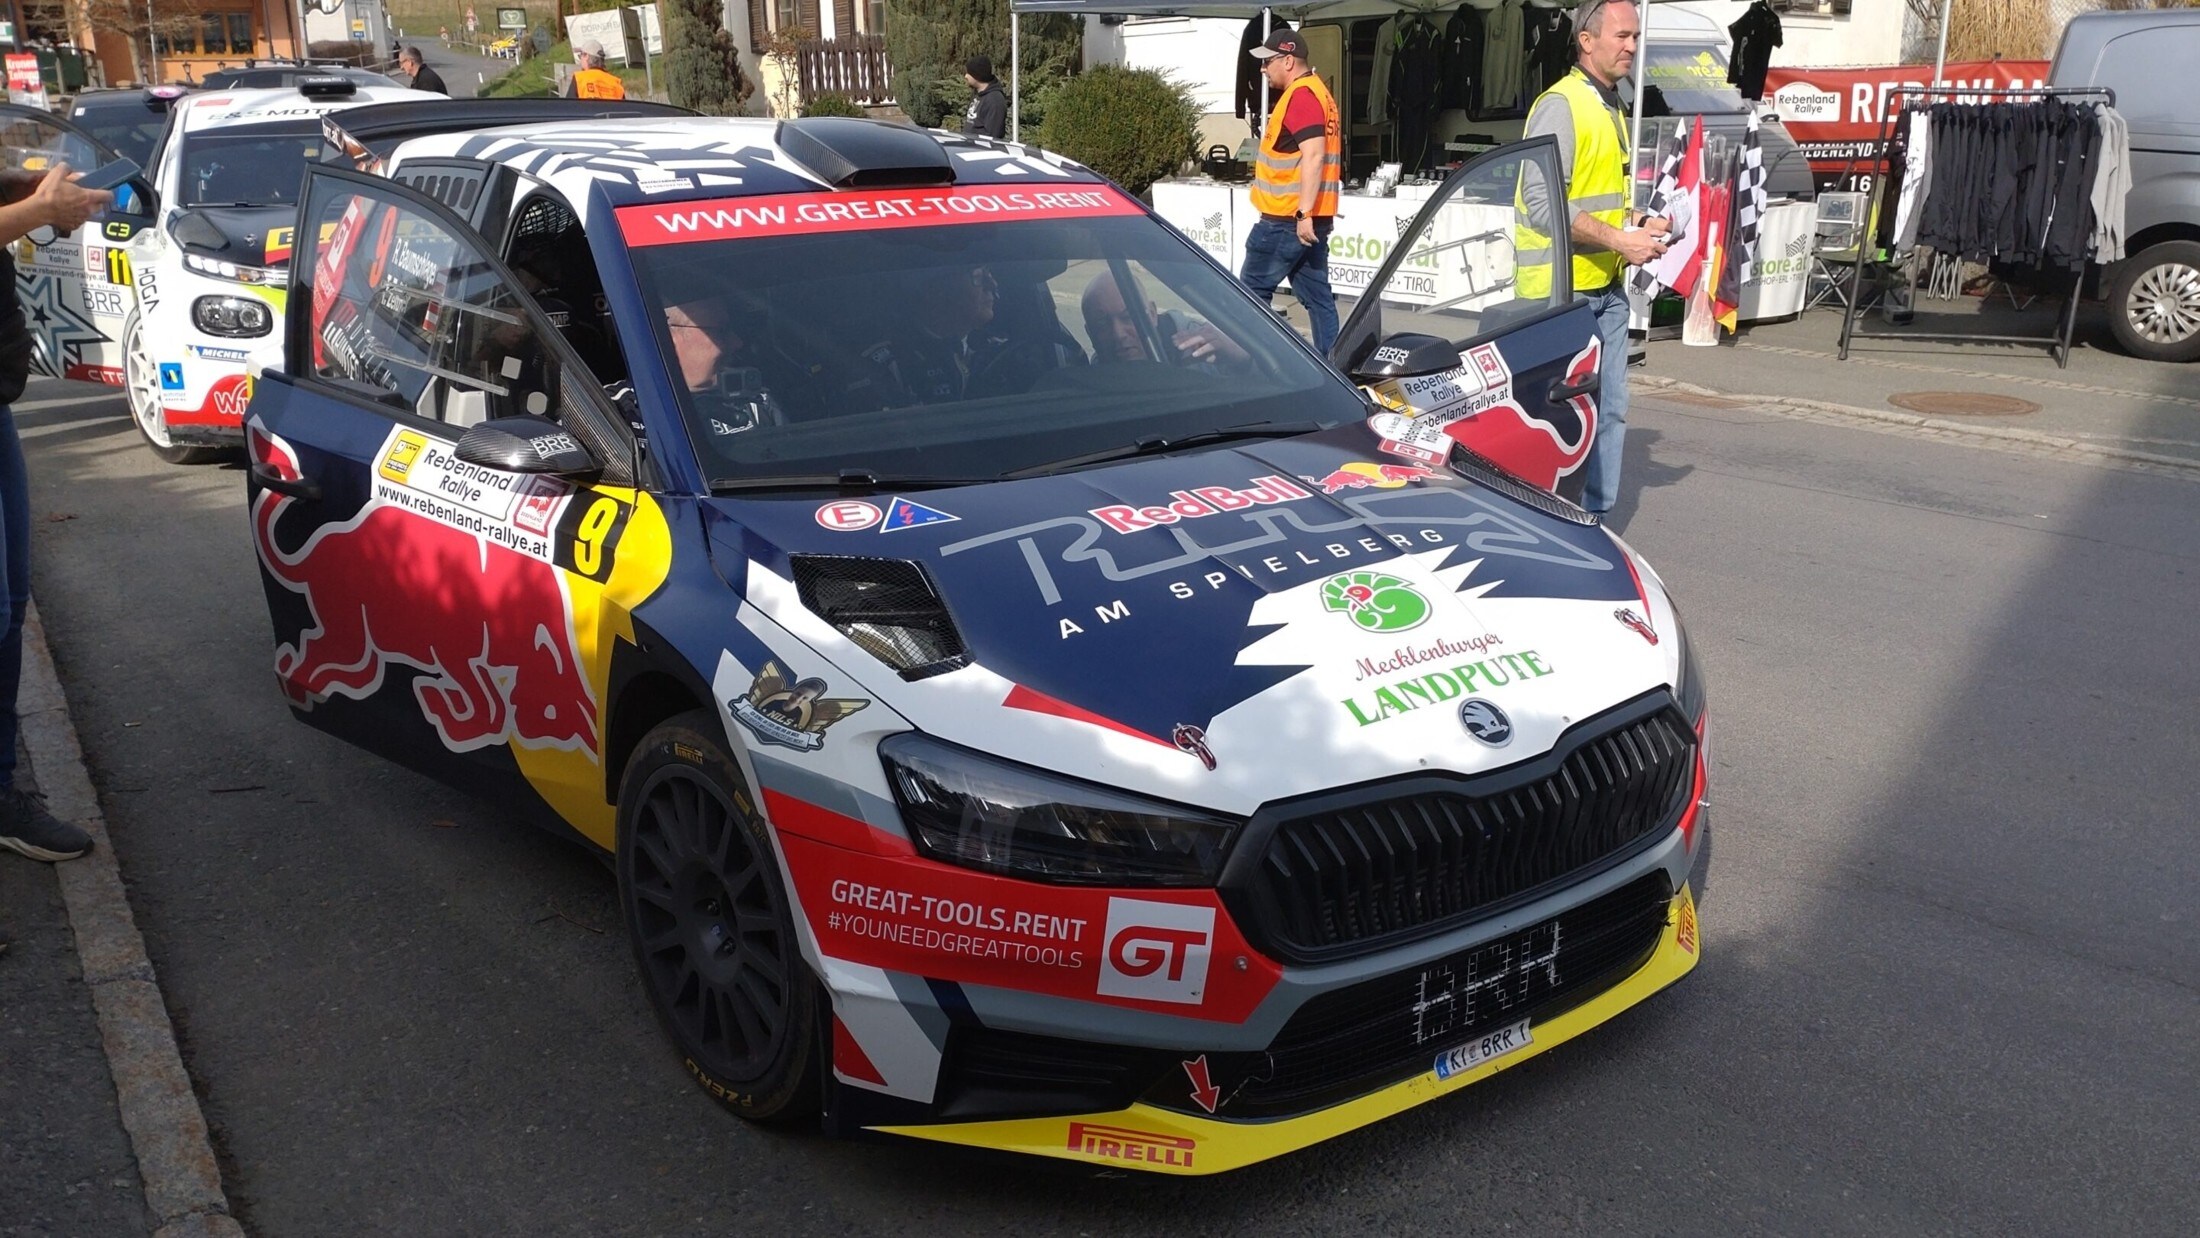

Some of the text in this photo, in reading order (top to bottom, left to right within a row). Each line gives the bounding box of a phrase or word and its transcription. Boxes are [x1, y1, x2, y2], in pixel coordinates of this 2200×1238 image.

[1778, 94, 1836, 104] Rebenland
[1794, 104, 1823, 115] Rallye
[106, 222, 130, 237] C3
[369, 204, 397, 288] 9
[107, 248, 132, 286] 11
[1403, 275, 1437, 294] TIROL
[82, 289, 125, 313] BRR
[202, 348, 248, 360] MICHEL
[1375, 347, 1409, 365] BRR
[1432, 384, 1463, 404] Rallye
[532, 436, 575, 458] BRR
[424, 448, 513, 492] Rebenland
[438, 474, 482, 502] Rallye
[378, 484, 548, 558] www.rebenland-rallye.at
[831, 505, 863, 525] E
[574, 497, 619, 576] 9
[1058, 528, 1443, 640] AM SPIELBERG
[1355, 631, 1503, 682] Mecklenburger
[1341, 649, 1555, 727] LANDPUTE
[766, 709, 794, 728] NILS
[831, 879, 1087, 943] GREAT-TOOLS.RENT
[827, 911, 1084, 969] #YOUNEEDGREATTOOLS
[1108, 925, 1207, 982] GT
[1449, 1049, 1468, 1071] KI
[1482, 1029, 1512, 1058] BRR
[1067, 1122, 1196, 1168] PIRELLI
